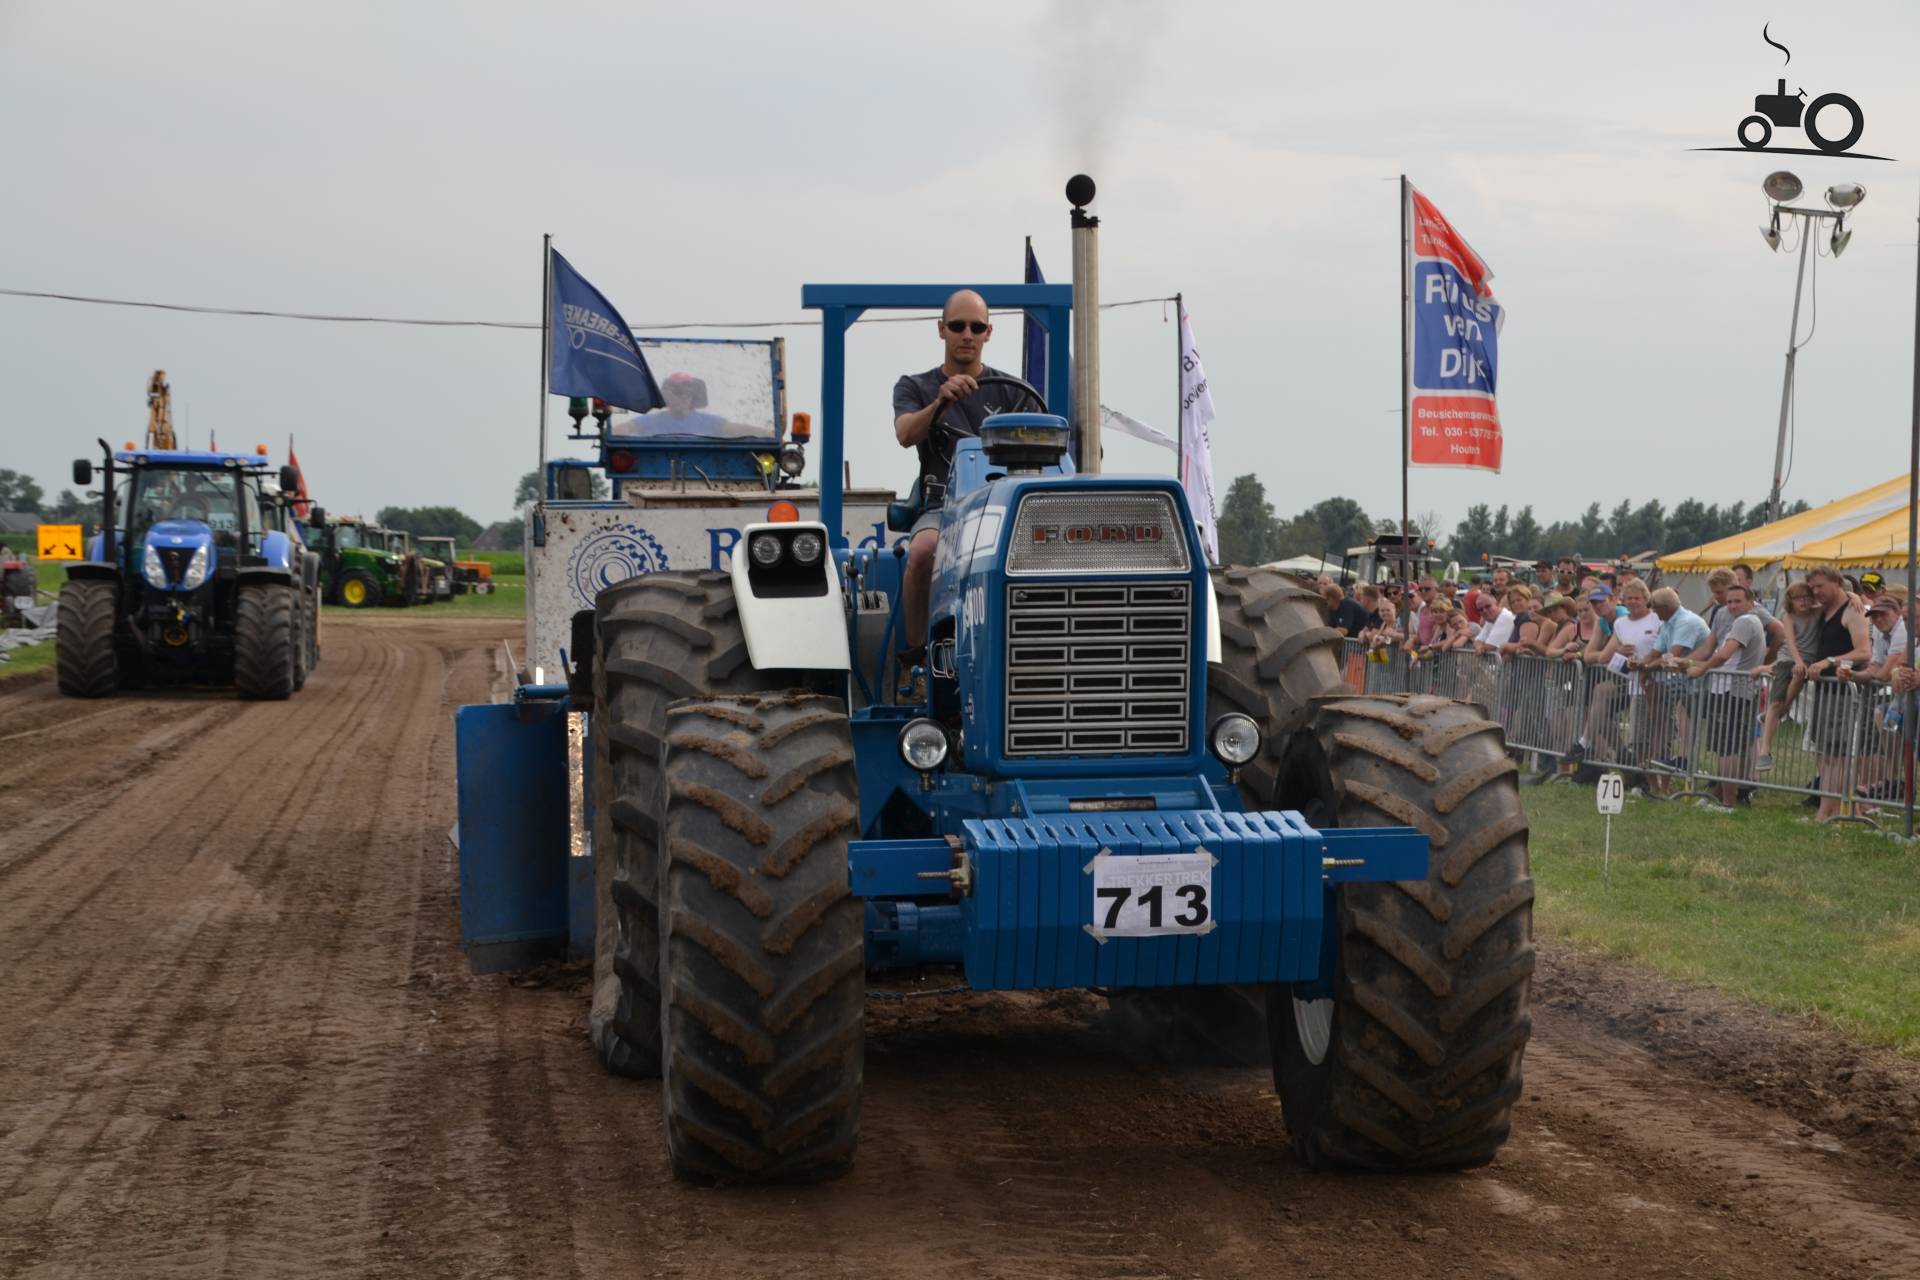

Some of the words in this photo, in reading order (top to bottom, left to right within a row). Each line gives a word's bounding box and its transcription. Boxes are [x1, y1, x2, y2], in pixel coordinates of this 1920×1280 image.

[1443, 314, 1483, 341] van
[1420, 426, 1439, 437] Tel.
[1444, 427, 1462, 437] 030
[1033, 524, 1162, 545] FORD
[1602, 780, 1621, 799] 70
[1096, 884, 1209, 929] 713
